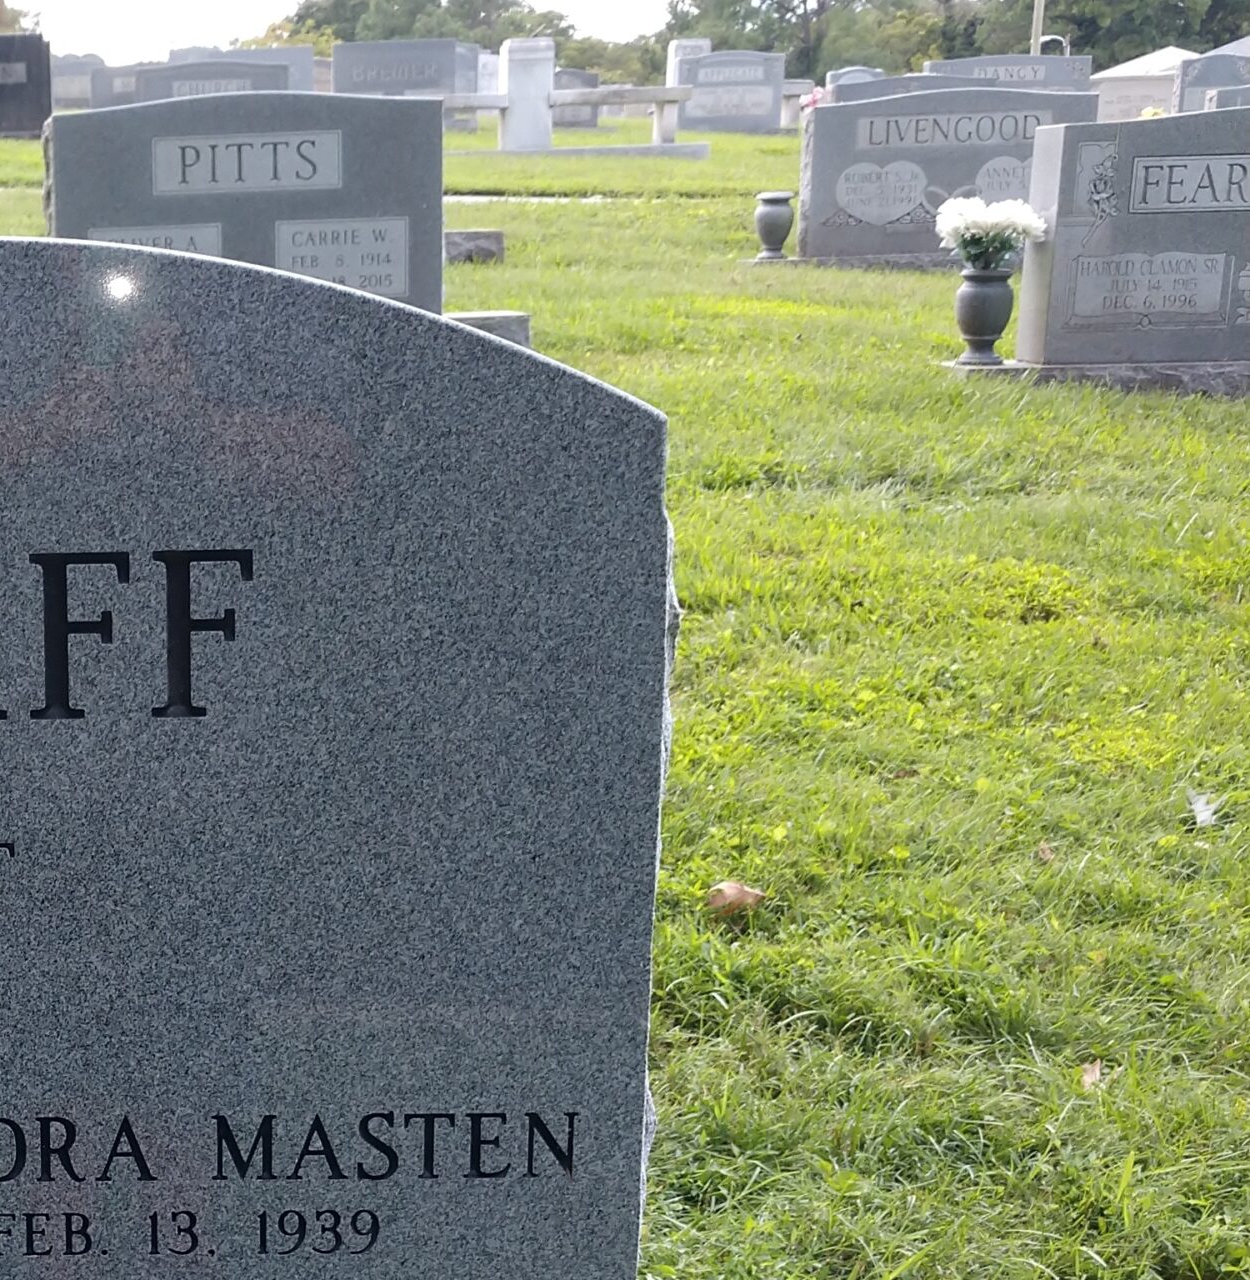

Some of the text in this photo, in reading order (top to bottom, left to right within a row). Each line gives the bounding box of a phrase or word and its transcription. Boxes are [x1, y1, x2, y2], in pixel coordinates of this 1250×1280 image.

[867, 114, 1041, 147] LIVENGOOD
[177, 138, 318, 185] PITTS
[1138, 163, 1249, 206] FEAR
[290, 229, 363, 248] CARRIE
[360, 253, 394, 267] 1914
[1080, 259, 1135, 277] HAROLD
[358, 273, 394, 289] 2015
[1106, 278, 1138, 294] JULY
[1162, 294, 1199, 310] 1996
[209, 1109, 581, 1182] MASTEN
[256, 1208, 382, 1256] 1939
